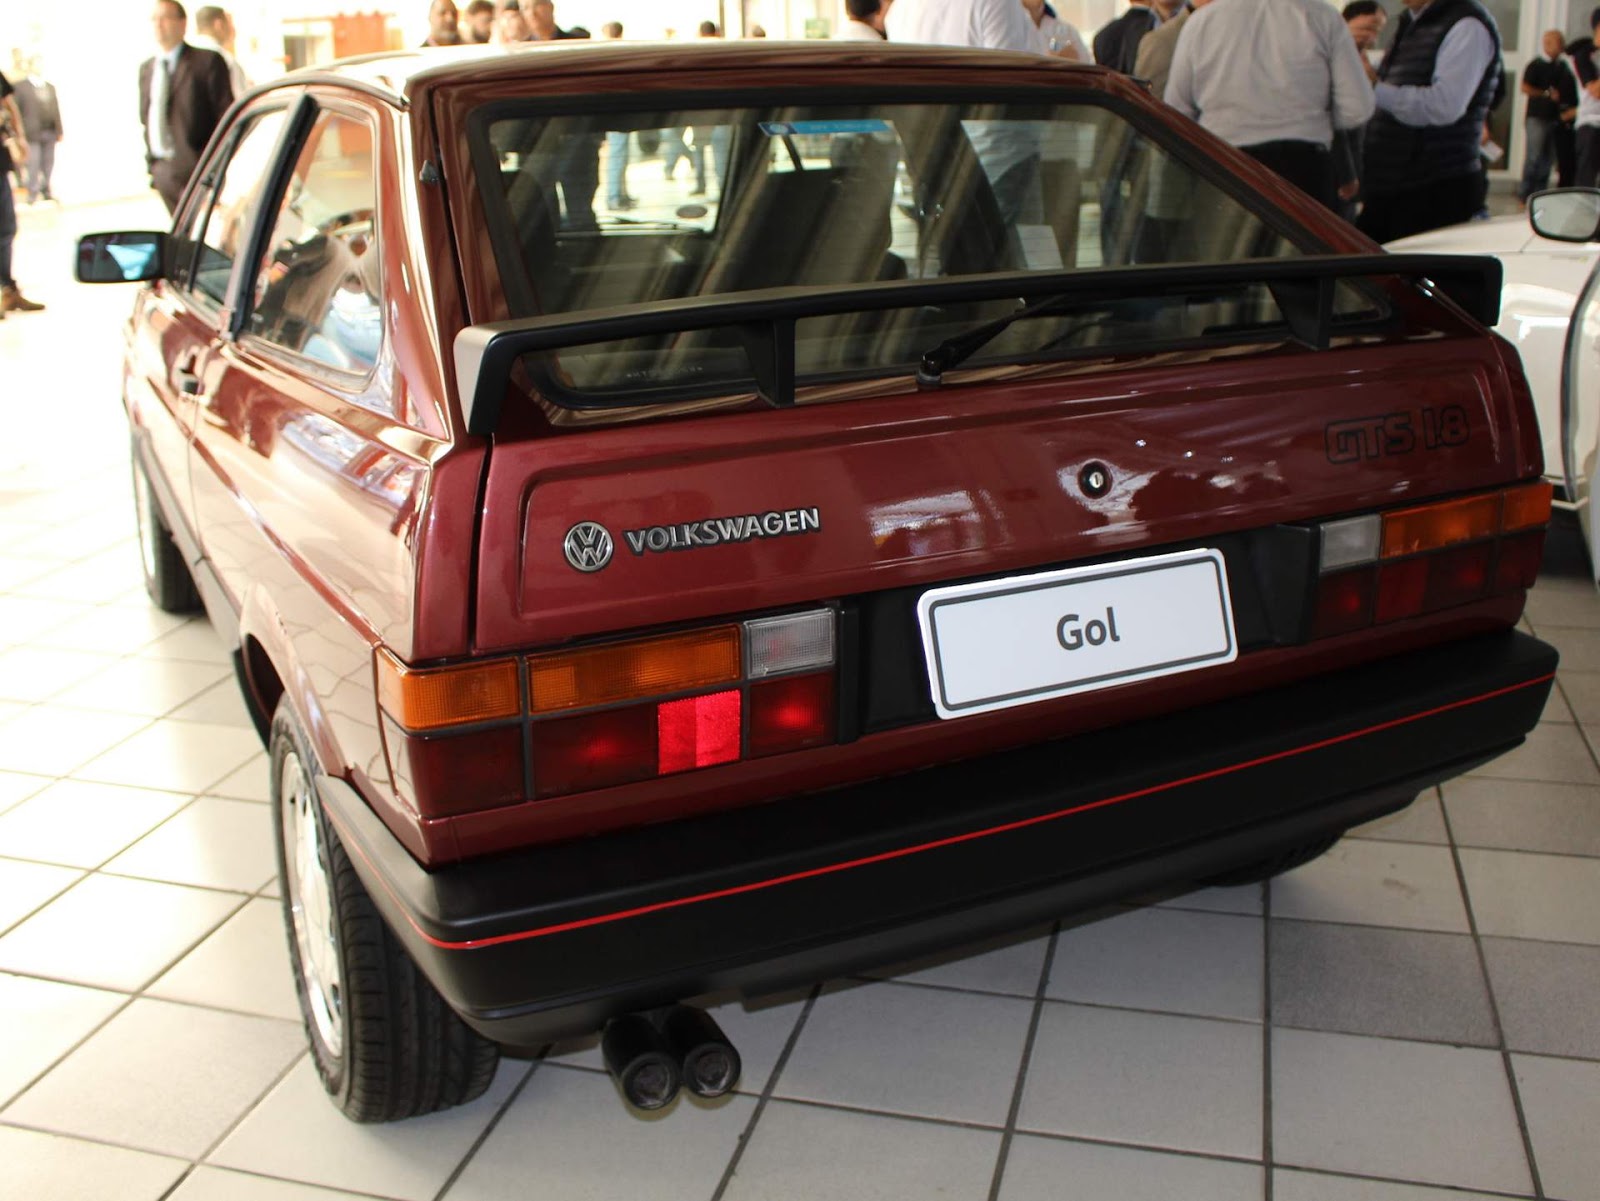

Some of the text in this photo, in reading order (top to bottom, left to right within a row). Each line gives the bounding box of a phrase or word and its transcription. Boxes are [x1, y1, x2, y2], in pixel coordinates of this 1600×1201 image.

[1325, 412, 1415, 465] GTS
[624, 506, 821, 555] VOLKSWAGEN
[1056, 606, 1120, 651] Gol
